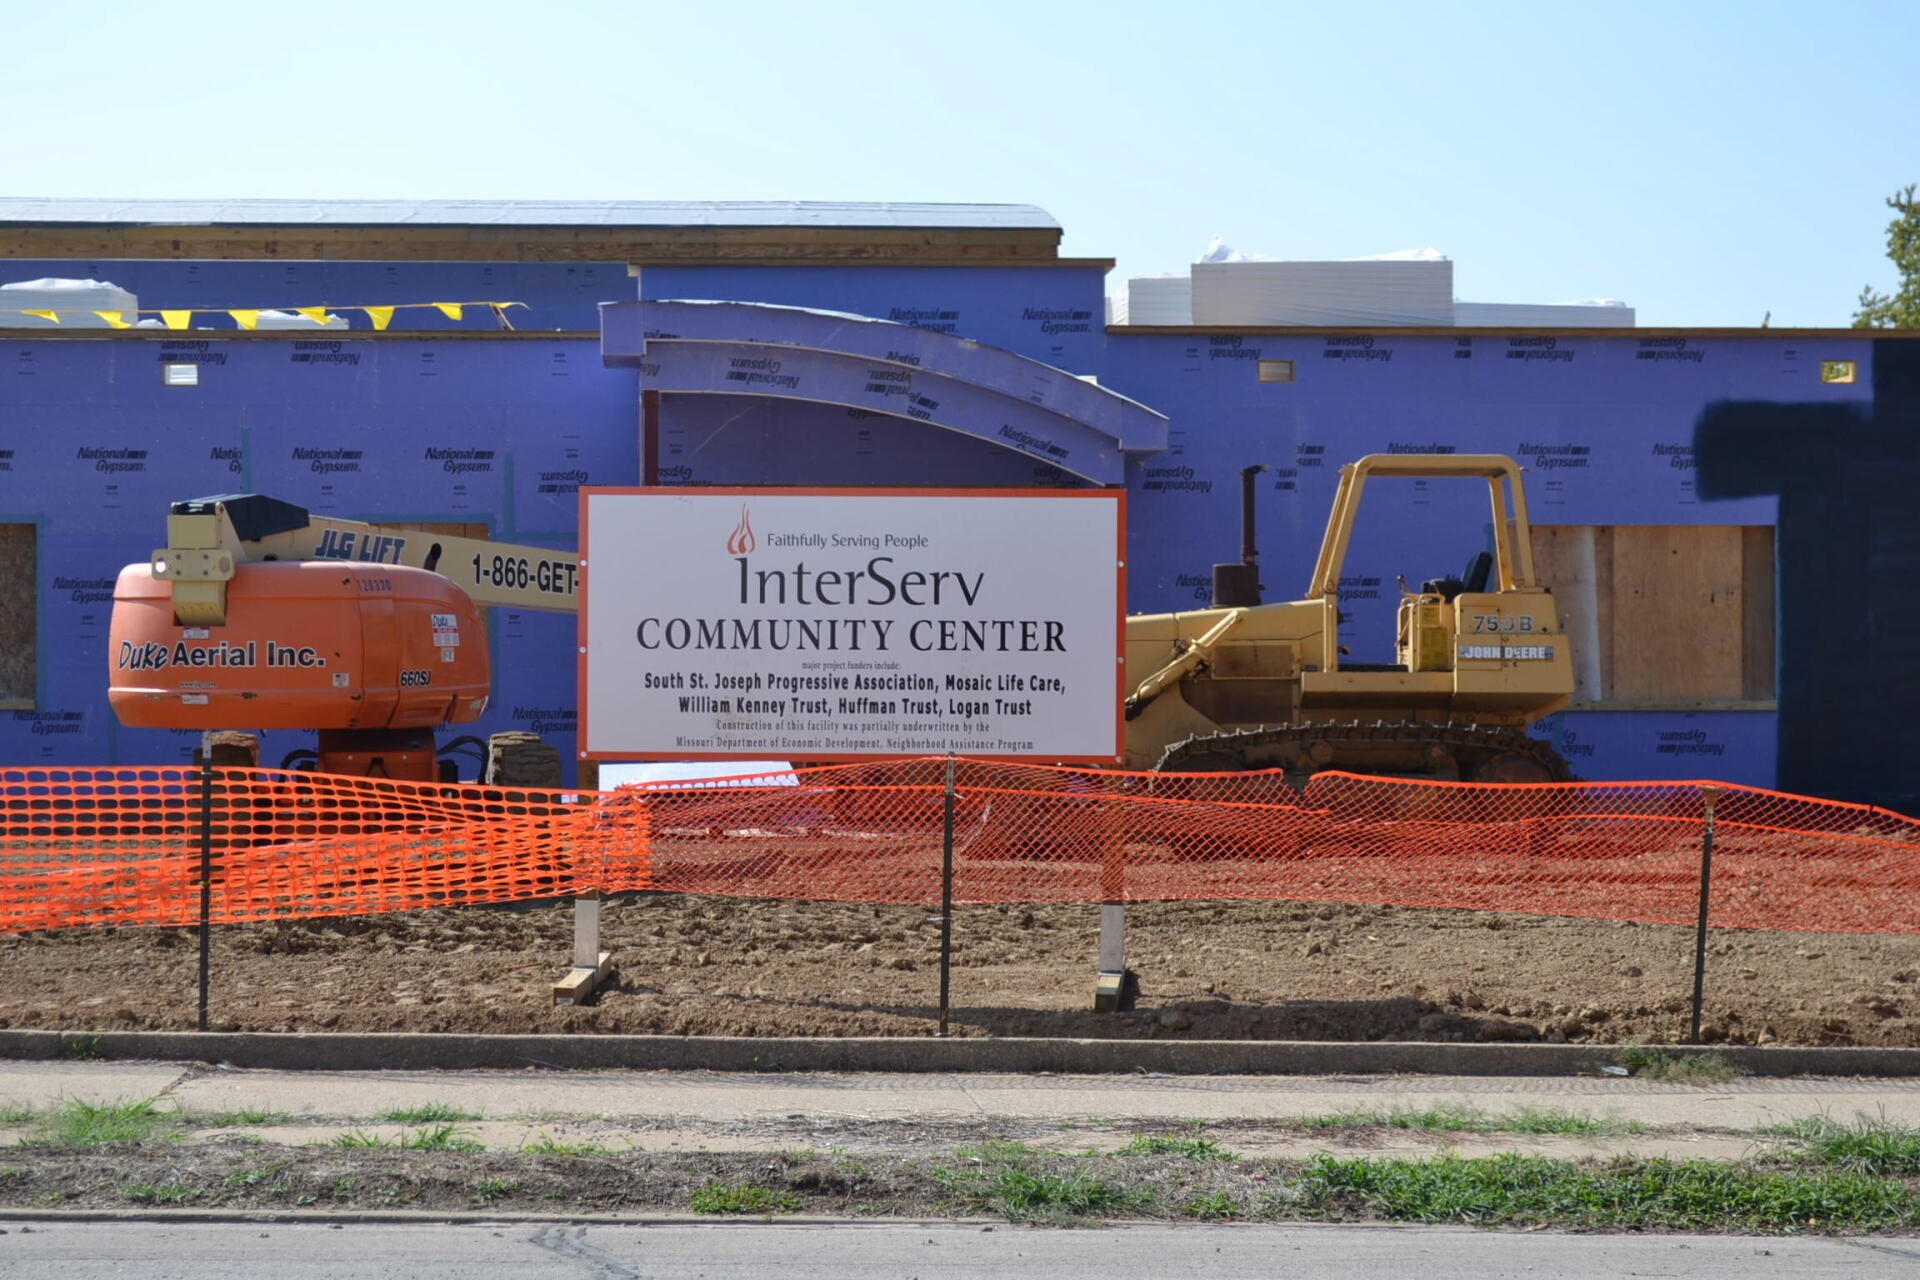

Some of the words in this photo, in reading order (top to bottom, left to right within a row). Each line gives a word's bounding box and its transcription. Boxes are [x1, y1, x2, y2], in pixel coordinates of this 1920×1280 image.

[889, 308, 940, 320] National
[1022, 308, 1073, 320] National
[76, 447, 128, 459] National
[292, 447, 343, 459] National
[424, 448, 475, 460] National
[1517, 443, 1572, 455] National
[314, 528, 357, 560] JLG
[358, 533, 407, 565] LIFT
[767, 533, 828, 550] Faithfully
[832, 533, 880, 550] Serving
[884, 534, 929, 550] People
[734, 556, 985, 607] InterServ
[1473, 614, 1533, 633] 750B
[636, 617, 895, 651] COMMUNITY
[909, 619, 1067, 653] CENTER
[171, 640, 256, 667] Aerial
[266, 640, 326, 667] Inc.
[1465, 647, 1501, 659] JOHN
[1504, 647, 1546, 659] DEERE
[801, 661, 821, 671] major
[823, 660, 846, 671] project
[848, 661, 872, 670] funders
[400, 670, 432, 687] 660SJ
[644, 672, 684, 689] South
[690, 673, 709, 689] St.
[714, 673, 762, 693] Joseph
[767, 673, 849, 693] Progressive
[854, 673, 940, 693] Association,
[945, 674, 993, 691] Mosaic
[998, 674, 1024, 691] Life
[1029, 675, 1066, 694] Care,
[512, 707, 563, 720] National
[679, 696, 731, 713] William
[736, 697, 786, 717] Kenney
[791, 697, 832, 717] Trust,
[838, 697, 896, 714] Huffman
[901, 698, 943, 718] Trust,
[949, 698, 990, 718] Logan
[995, 699, 1032, 715] Trust
[716, 719, 772, 731] Construction
[775, 719, 784, 730] of
[787, 720, 804, 731] this
[807, 720, 839, 732] facility
[843, 722, 859, 731] was
[861, 720, 899, 733] partially
[903, 720, 960, 732] underwritten
[963, 721, 973, 733] by
[976, 721, 990, 732] the
[676, 736, 713, 747] Missouri
[717, 737, 767, 749] Department
[770, 737, 779, 747] of
[782, 737, 822, 748] Economic
[886, 738, 946, 750] Neighborhood
[950, 739, 994, 749] Assistance
[998, 739, 1034, 751] Program
